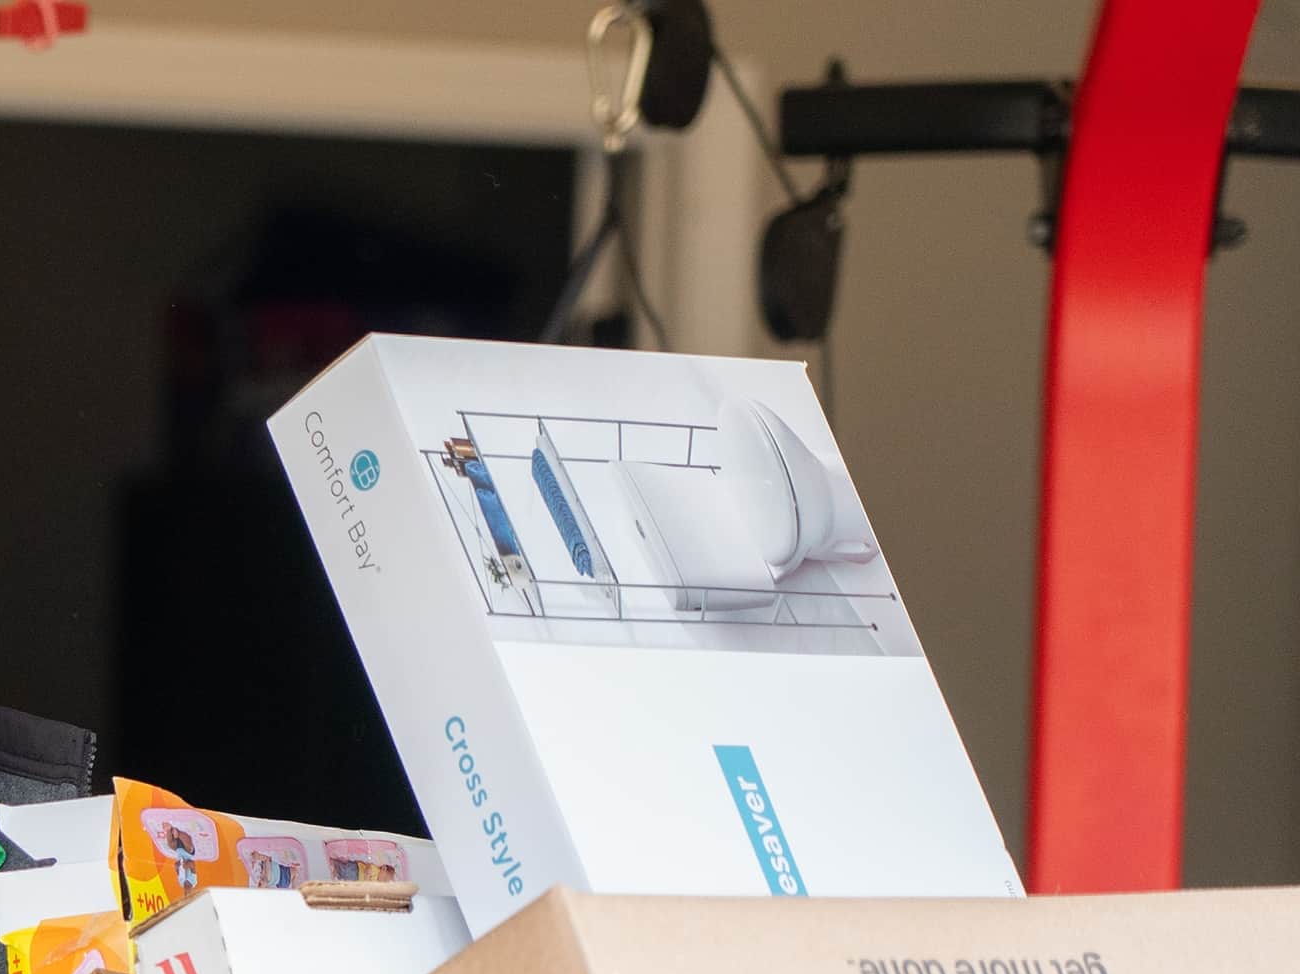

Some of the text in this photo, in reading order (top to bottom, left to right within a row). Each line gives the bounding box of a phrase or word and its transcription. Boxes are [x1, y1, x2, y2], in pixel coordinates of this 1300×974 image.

[305, 411, 376, 570] Comfort Bay
[445, 715, 523, 896] Cross Style
